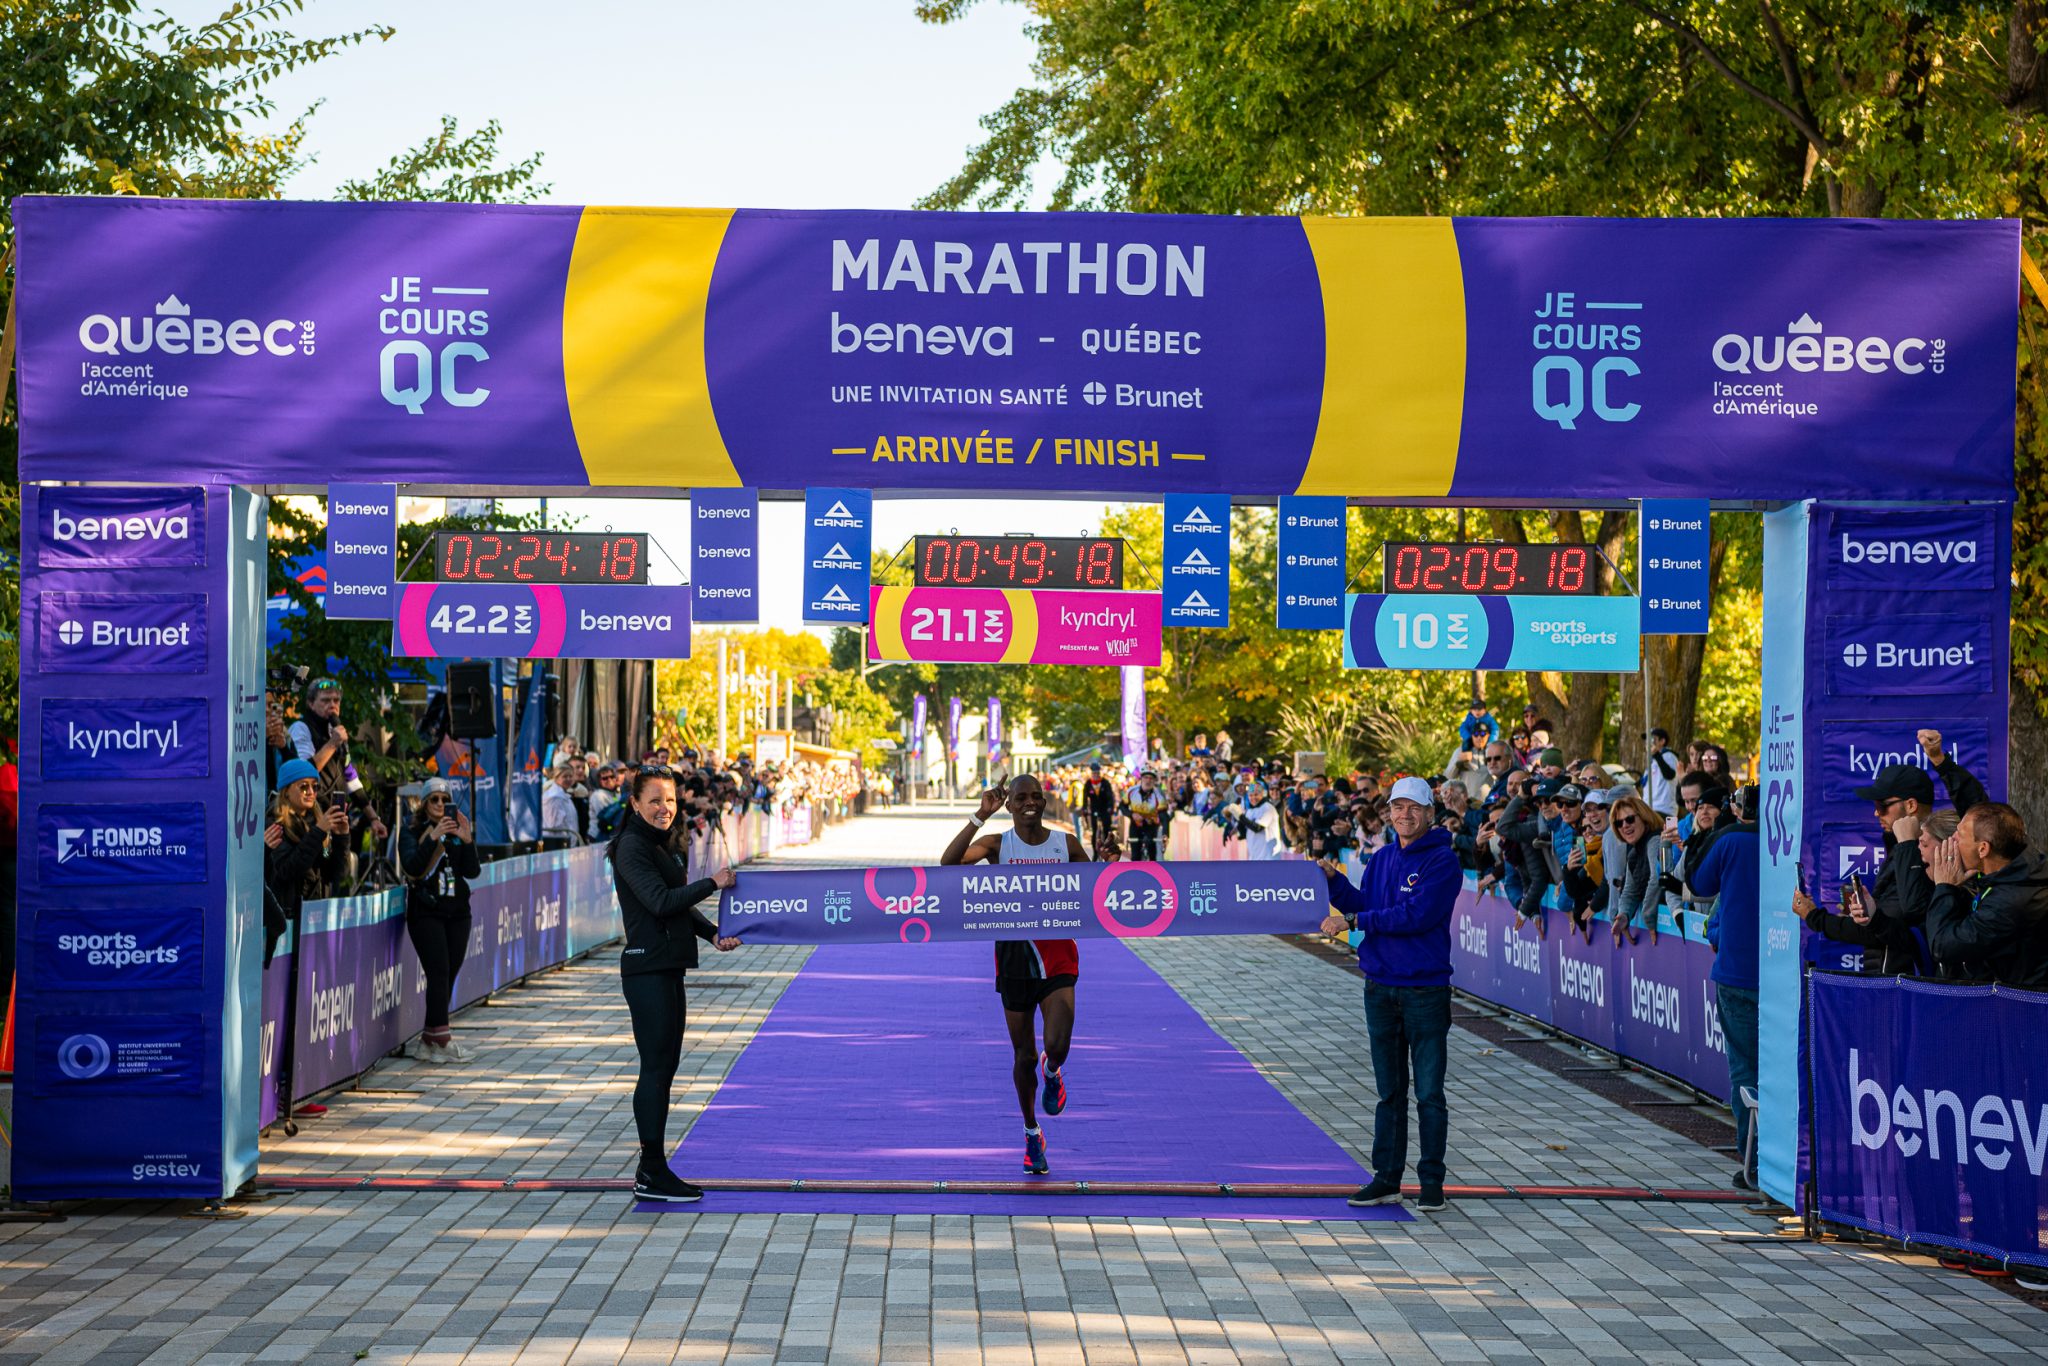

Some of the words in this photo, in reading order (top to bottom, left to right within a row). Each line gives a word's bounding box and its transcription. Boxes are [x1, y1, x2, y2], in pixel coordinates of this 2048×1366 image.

[831, 238, 1205, 298] MARATHON
[380, 276, 420, 303] JE
[1534, 292, 1574, 318] JE
[380, 308, 489, 336] COURS
[831, 312, 1014, 356] beneva
[1082, 323, 1202, 356] QUÉBEC
[1533, 324, 1642, 351] COURS
[380, 340, 490, 415] QC
[832, 385, 872, 404] UNE
[879, 385, 992, 406] INVITATION
[1000, 384, 1068, 406] SANTÉ
[1116, 383, 1203, 410] Brunet
[1532, 356, 1642, 430] QC
[872, 430, 1014, 465] ARRIVÉE
[1055, 438, 1159, 468] FINISH
[335, 501, 388, 516] beneva
[698, 506, 750, 520] beneva
[54, 509, 188, 540] beneva
[814, 518, 864, 530] CANAC
[1172, 524, 1222, 534] CANAC
[1300, 516, 1338, 528] Brunet
[1662, 519, 1702, 530] Brunet
[334, 541, 388, 555] beneva
[698, 545, 750, 559] beneva
[1842, 533, 1976, 564] beneva
[812, 560, 862, 571] CANAC
[1172, 566, 1221, 576] CANAC
[1299, 556, 1338, 568] Brunet
[1662, 558, 1702, 570] Brunet
[334, 581, 387, 596] beneva
[698, 585, 751, 599] beneva
[811, 602, 860, 612] CANAC
[1170, 607, 1220, 618] CANAC
[1298, 595, 1338, 607] Brunet
[1662, 598, 1702, 610] Brunet
[430, 604, 508, 634] 42.2
[514, 604, 532, 634] KM
[581, 609, 672, 632] beneva
[910, 607, 977, 642] 21.1
[984, 609, 1004, 643] KM
[1061, 606, 1135, 633] kyndryl
[1530, 619, 1586, 636] sports
[92, 620, 190, 646] Brunet
[1392, 613, 1438, 649] 10
[1448, 613, 1468, 650] KM
[1550, 630, 1617, 647] experts
[1876, 642, 1974, 668] Brunet
[234, 684, 243, 713] JE
[1768, 704, 1780, 735] JE
[68, 720, 180, 758] kyndryl
[234, 721, 258, 753] COURS
[1768, 740, 1795, 772] COURS
[234, 759, 258, 850] QC
[1765, 778, 1794, 867] QC
[92, 827, 162, 846] FONDS
[92, 847, 107, 856] de
[109, 844, 163, 857] solidarité
[166, 846, 187, 856] FTQ
[962, 874, 1080, 894] MARATHON
[1235, 884, 1315, 902] beneva
[730, 896, 808, 915] beneva
[884, 896, 940, 914] 2022
[963, 900, 1021, 914] beneva
[1042, 900, 1080, 910] QUÉBEC
[1104, 889, 1158, 910] 42.2
[1161, 888, 1174, 910] KM
[1190, 896, 1218, 916] QC
[824, 905, 852, 924] QC
[1016, 920, 1038, 928] SANTÉ
[1052, 919, 1081, 928] Brunet
[58, 930, 136, 954] sports
[1466, 917, 1488, 958] Brunet
[87, 945, 179, 968] experts
[1512, 930, 1541, 975] Brunet
[1559, 939, 1604, 1008] beneva
[372, 958, 403, 1021] beneva
[1630, 958, 1680, 1034] beneva
[310, 972, 356, 1044] beneva
[132, 1162, 201, 1181] gestev
